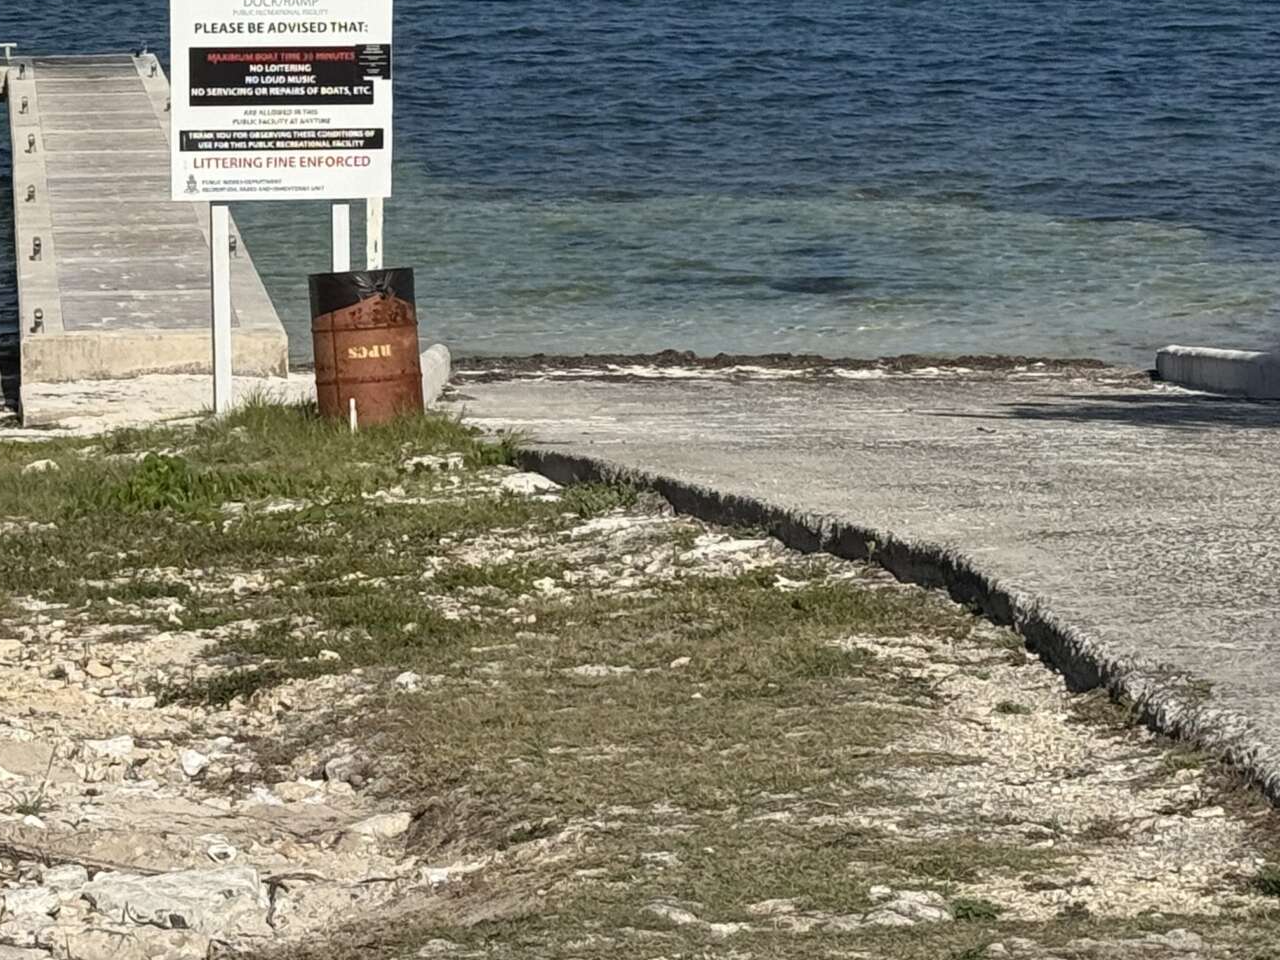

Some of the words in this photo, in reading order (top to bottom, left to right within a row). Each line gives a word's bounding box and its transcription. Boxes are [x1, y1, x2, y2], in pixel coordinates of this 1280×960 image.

[194, 22, 244, 34] PLEASE
[247, 22, 265, 34] BE
[267, 21, 327, 34] ADVISED
[330, 21, 369, 33] THAT:
[207, 53, 254, 62] MAXIMUM
[280, 52, 301, 61] TIME
[315, 51, 356, 61] MINUTES
[249, 64, 264, 73] NO
[265, 63, 312, 73] LOITERING
[245, 75, 260, 84] NO
[261, 75, 286, 84] LOUD
[287, 74, 317, 84] MUSIC
[191, 87, 205, 97] NO
[206, 87, 254, 97] SERVICING
[255, 87, 268, 96] OR
[269, 86, 306, 96] REPAIRS
[307, 86, 319, 96] OF
[320, 86, 352, 96] BOATS,
[353, 85, 372, 95] ETC.
[258, 118, 289, 126] FACILITY
[216, 131, 232, 139] YOU
[233, 131, 248, 139] FOR
[365, 129, 376, 138] OF
[198, 141, 213, 149] USE
[214, 141, 229, 149] FOR
[230, 141, 247, 149] THIS
[248, 140, 275, 149] PUBLIC
[275, 139, 331, 148] RECREATIONAL
[332, 139, 365, 147] FACILITY
[193, 157, 263, 169] LITTERING
[266, 156, 297, 168] FINE
[300, 155, 371, 168] ENFORCED
